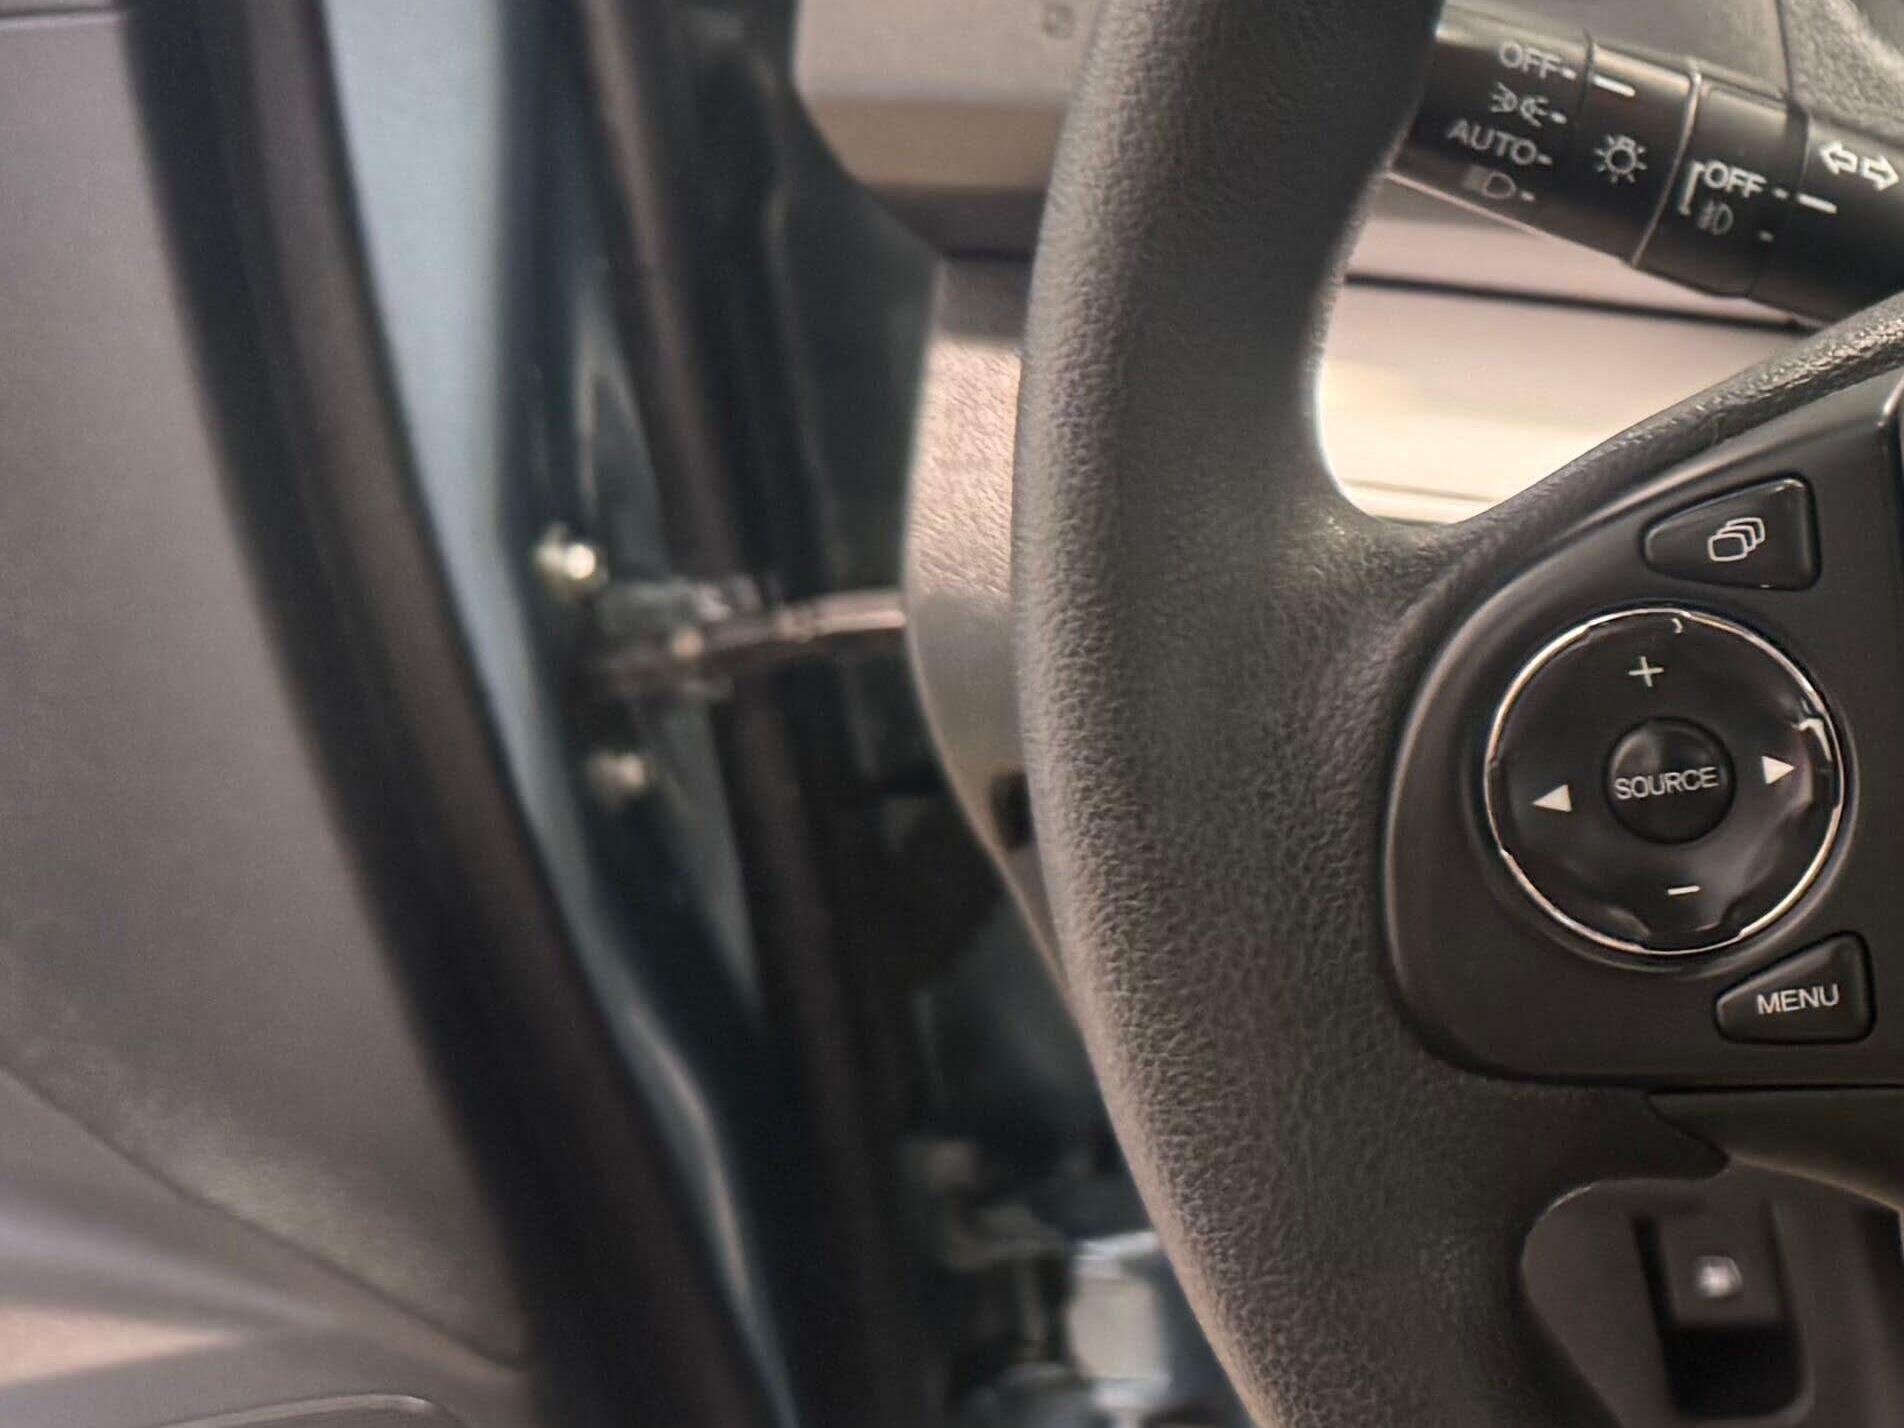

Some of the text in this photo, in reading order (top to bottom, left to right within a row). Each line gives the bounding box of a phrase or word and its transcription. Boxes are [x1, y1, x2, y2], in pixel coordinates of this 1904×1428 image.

[1500, 42, 1563, 80] OFF
[1447, 118, 1539, 166] AUTO
[1703, 164, 1768, 199] OFF
[1614, 767, 1719, 801] SOURCE
[1756, 984, 1840, 1016] MENU
